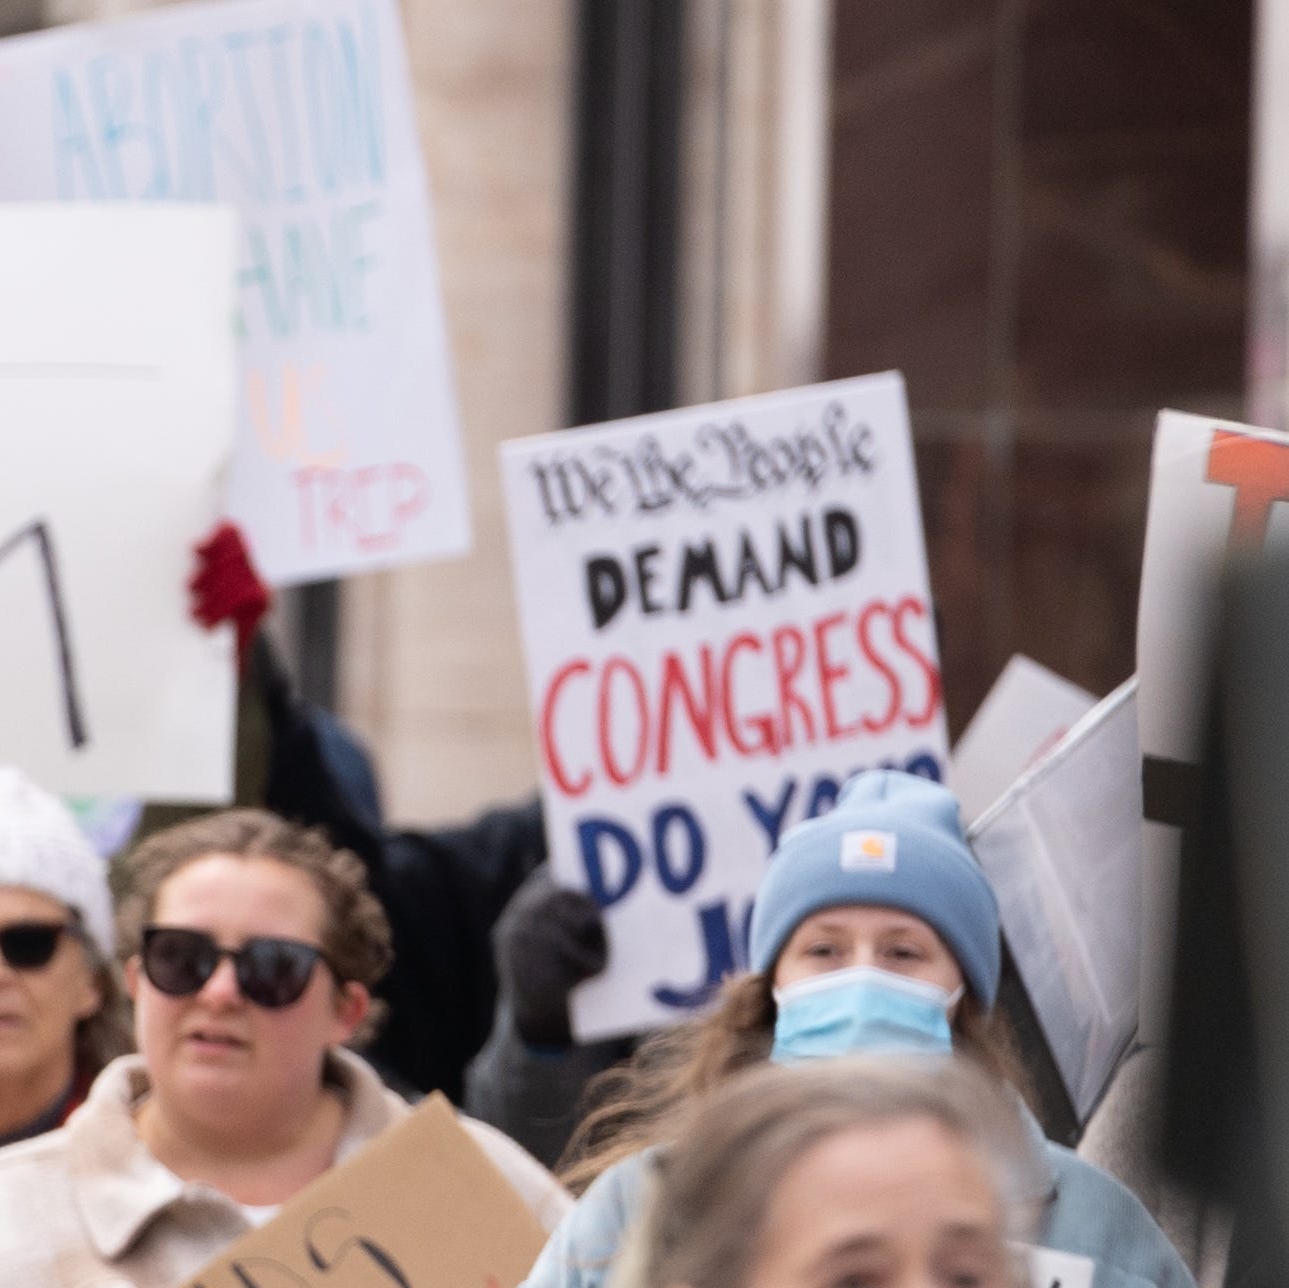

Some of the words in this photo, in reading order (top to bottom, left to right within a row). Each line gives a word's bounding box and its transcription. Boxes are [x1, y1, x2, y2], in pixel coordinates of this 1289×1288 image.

[50, 2, 389, 204] ABORTION
[231, 203, 381, 338] AVE
[585, 506, 861, 630] DEMAND
[540, 597, 944, 798] CONGRESS
[576, 804, 705, 908] DO
